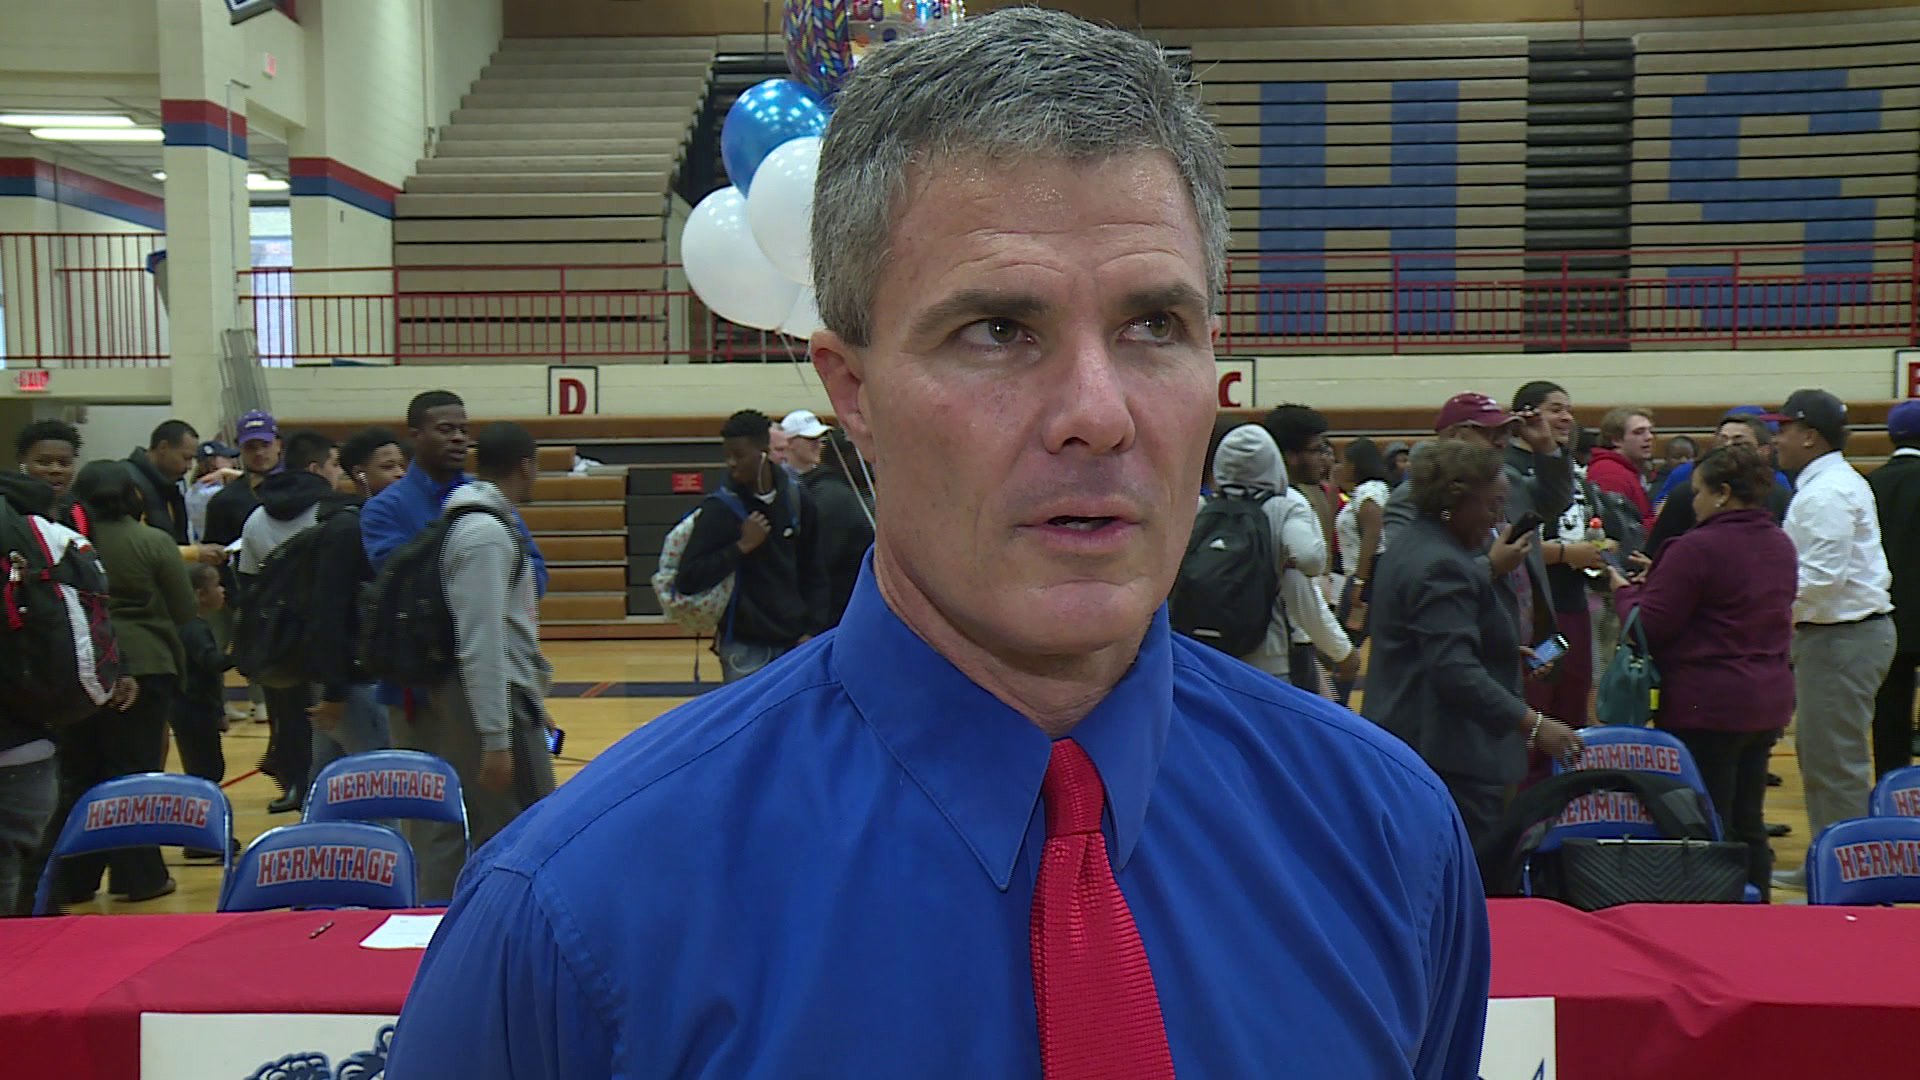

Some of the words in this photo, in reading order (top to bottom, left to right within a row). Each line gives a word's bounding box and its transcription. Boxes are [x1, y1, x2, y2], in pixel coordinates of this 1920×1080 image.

[559, 378, 587, 415] D
[1218, 372, 1242, 408] C
[327, 769, 447, 805] HERMITAGE
[85, 795, 213, 831] HERMITAGE
[1556, 791, 1655, 827] ERMITA
[256, 845, 399, 888] HERMITAGE
